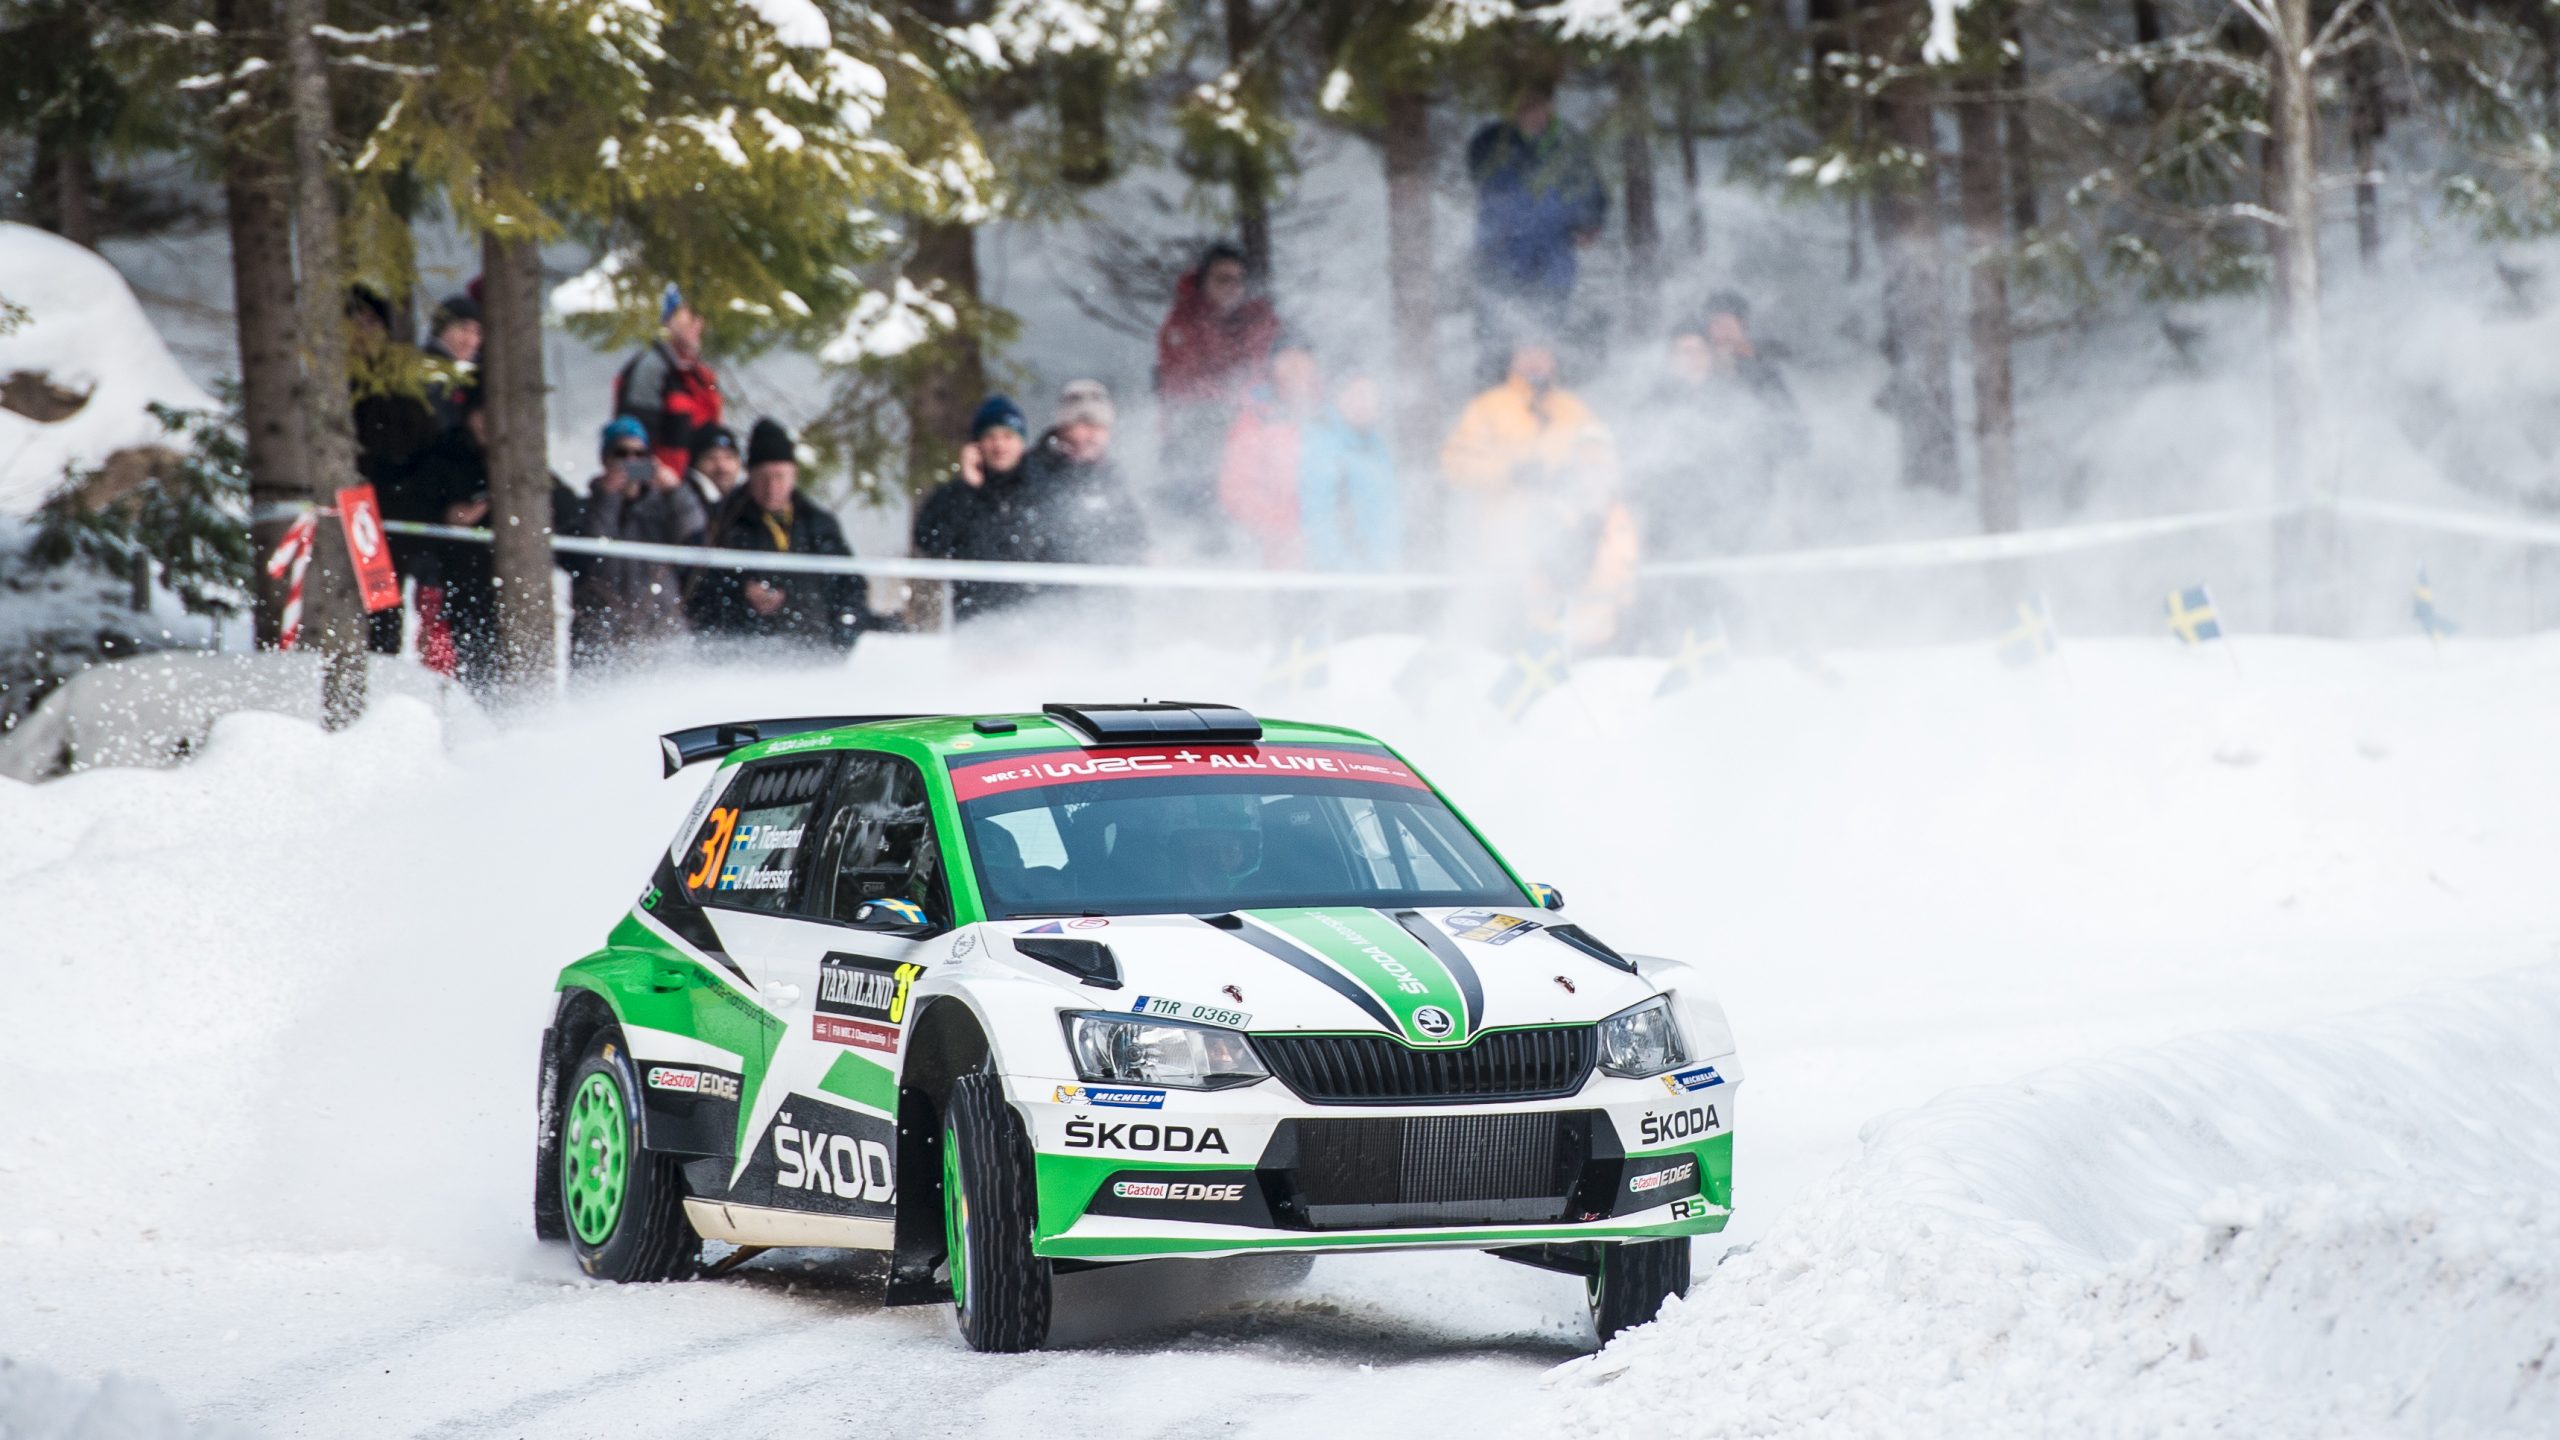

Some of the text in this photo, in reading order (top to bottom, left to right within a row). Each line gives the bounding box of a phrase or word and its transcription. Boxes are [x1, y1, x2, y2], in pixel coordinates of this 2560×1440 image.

[982, 768, 1033, 784] WRC 2
[1210, 754, 1267, 769] ALL
[1268, 755, 1339, 773] LIVE
[687, 807, 739, 889] 31
[747, 823, 805, 849] P. Tidemand
[1361, 945, 1429, 994] ŠKODA
[821, 958, 894, 1010] VÄRMLAND
[890, 962, 921, 1023] 31
[1153, 999, 1241, 1025] 11R 0368
[660, 1071, 740, 1102] Castrol EDGE
[1682, 1071, 1719, 1085] MICHELIN
[1093, 1092, 1164, 1103] MICHELIN
[1064, 1114, 1230, 1155] ŠKODA
[1641, 1104, 1720, 1145] ŠKODA
[774, 1111, 897, 1205] ŠKOD
[1638, 1162, 1694, 1189] Castrol EDGE
[1126, 1183, 1246, 1201] Castrol EDGE
[1670, 1199, 1706, 1220] R5
